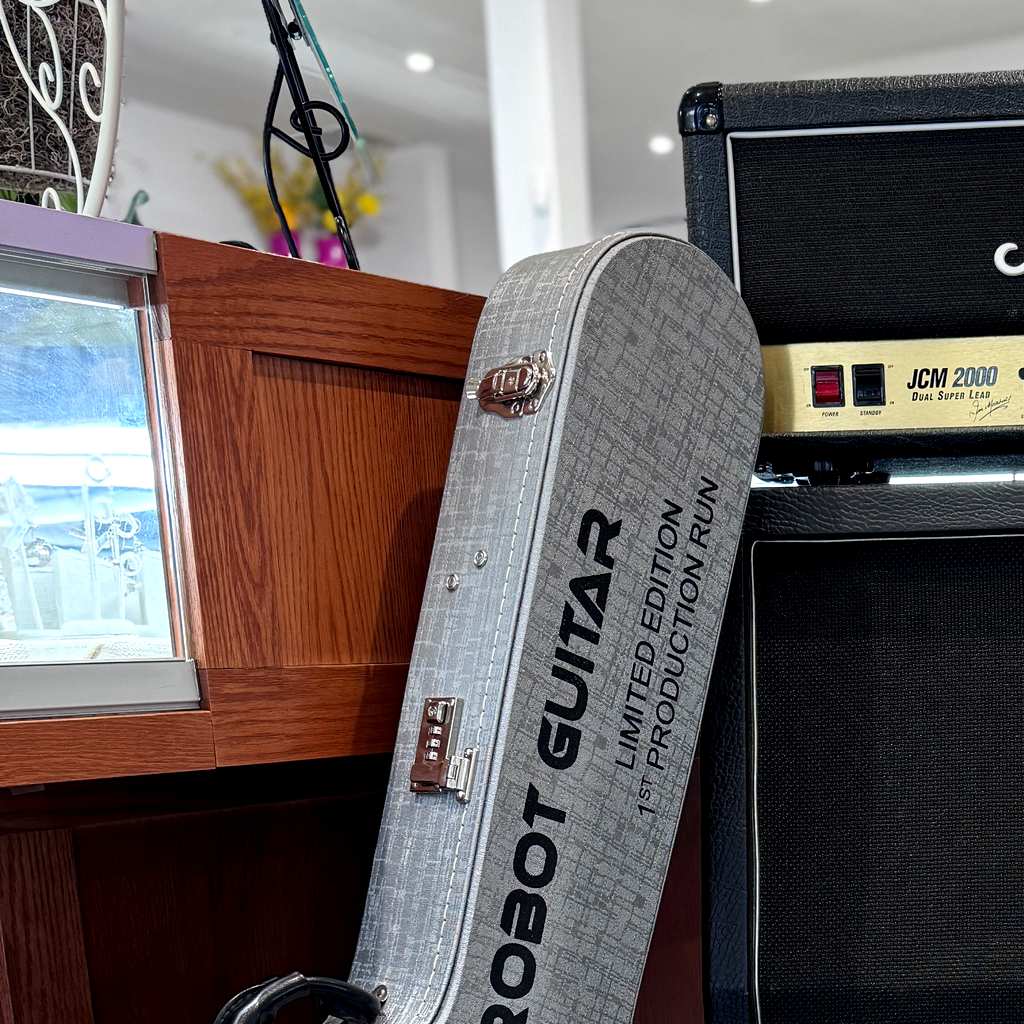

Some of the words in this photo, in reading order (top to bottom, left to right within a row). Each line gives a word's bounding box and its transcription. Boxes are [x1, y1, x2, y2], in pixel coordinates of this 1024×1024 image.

[907, 368, 948, 389] JCM
[952, 366, 998, 388] 2000
[912, 391, 933, 401] DUAL
[938, 390, 965, 400] SUPER
[969, 389, 990, 399] LEAD
[537, 508, 622, 770] GUITAR
[615, 640, 655, 770] LIMITED
[641, 498, 684, 634] EDITION
[646, 553, 705, 770] PRODUCTION
[689, 475, 720, 549] RUN
